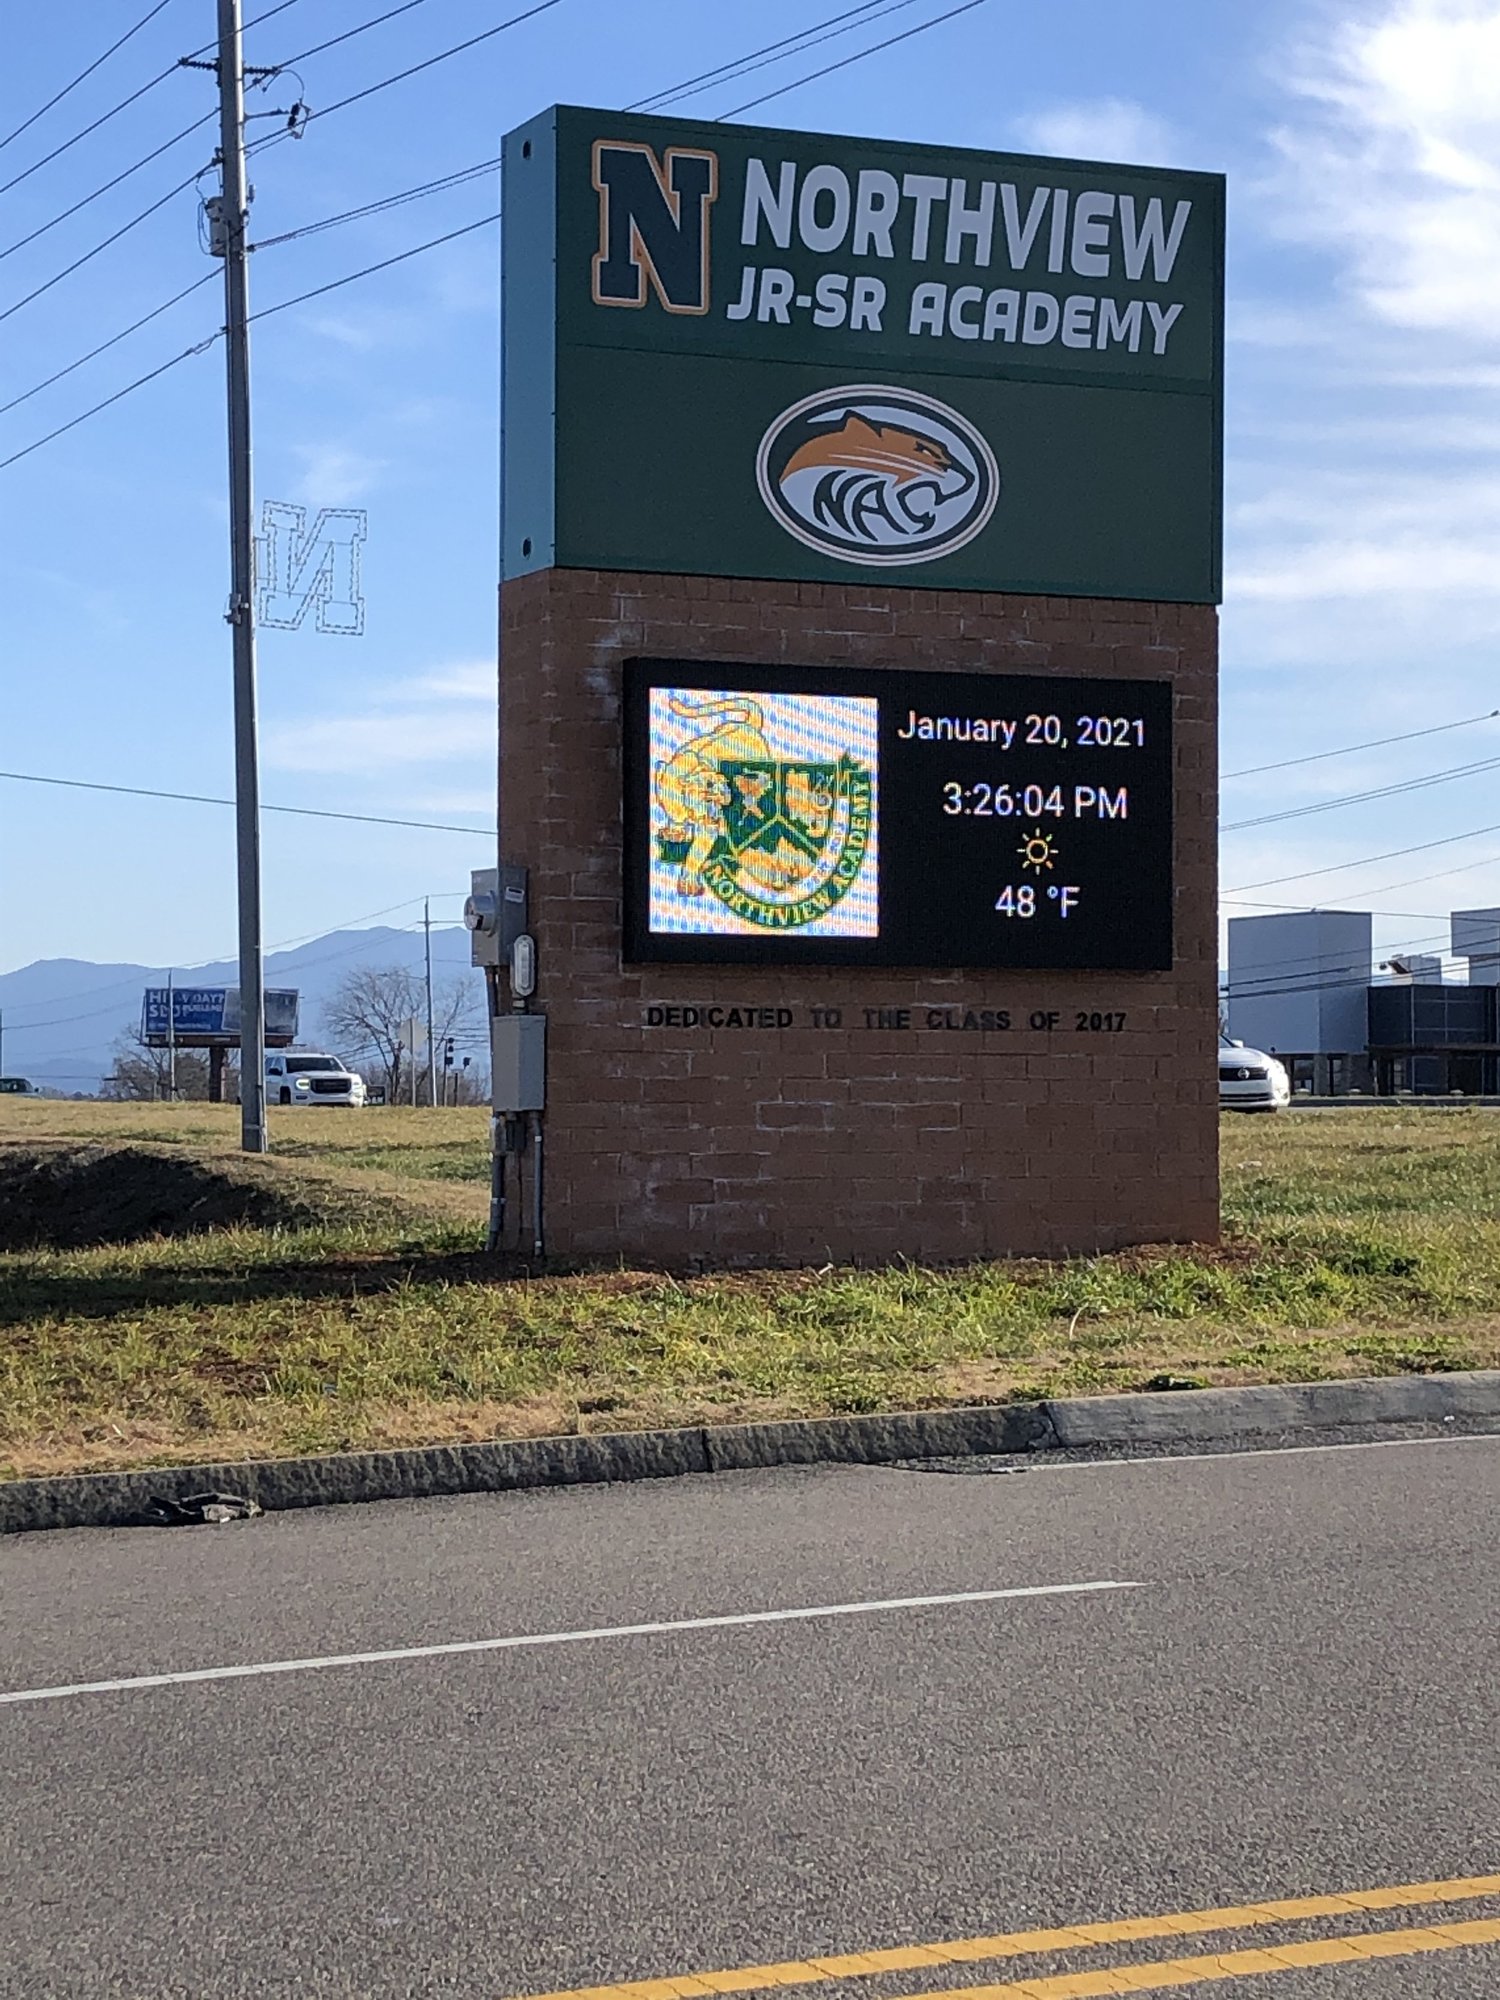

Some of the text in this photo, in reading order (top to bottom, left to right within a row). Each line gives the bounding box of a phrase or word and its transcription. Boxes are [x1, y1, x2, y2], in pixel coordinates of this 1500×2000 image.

[591, 139, 718, 315] N
[740, 157, 1193, 284] NORTHVIEW
[726, 266, 1185, 356] JR-SR ACADEMY
[813, 470, 941, 542] NAC
[898, 709, 1145, 750] January 20, 2021
[942, 782, 1128, 819] 3:26:04 PM
[994, 885, 1081, 919] 48 °F
[647, 1006, 1128, 1032] DEDICATED TO THE CLASS OF 2017
